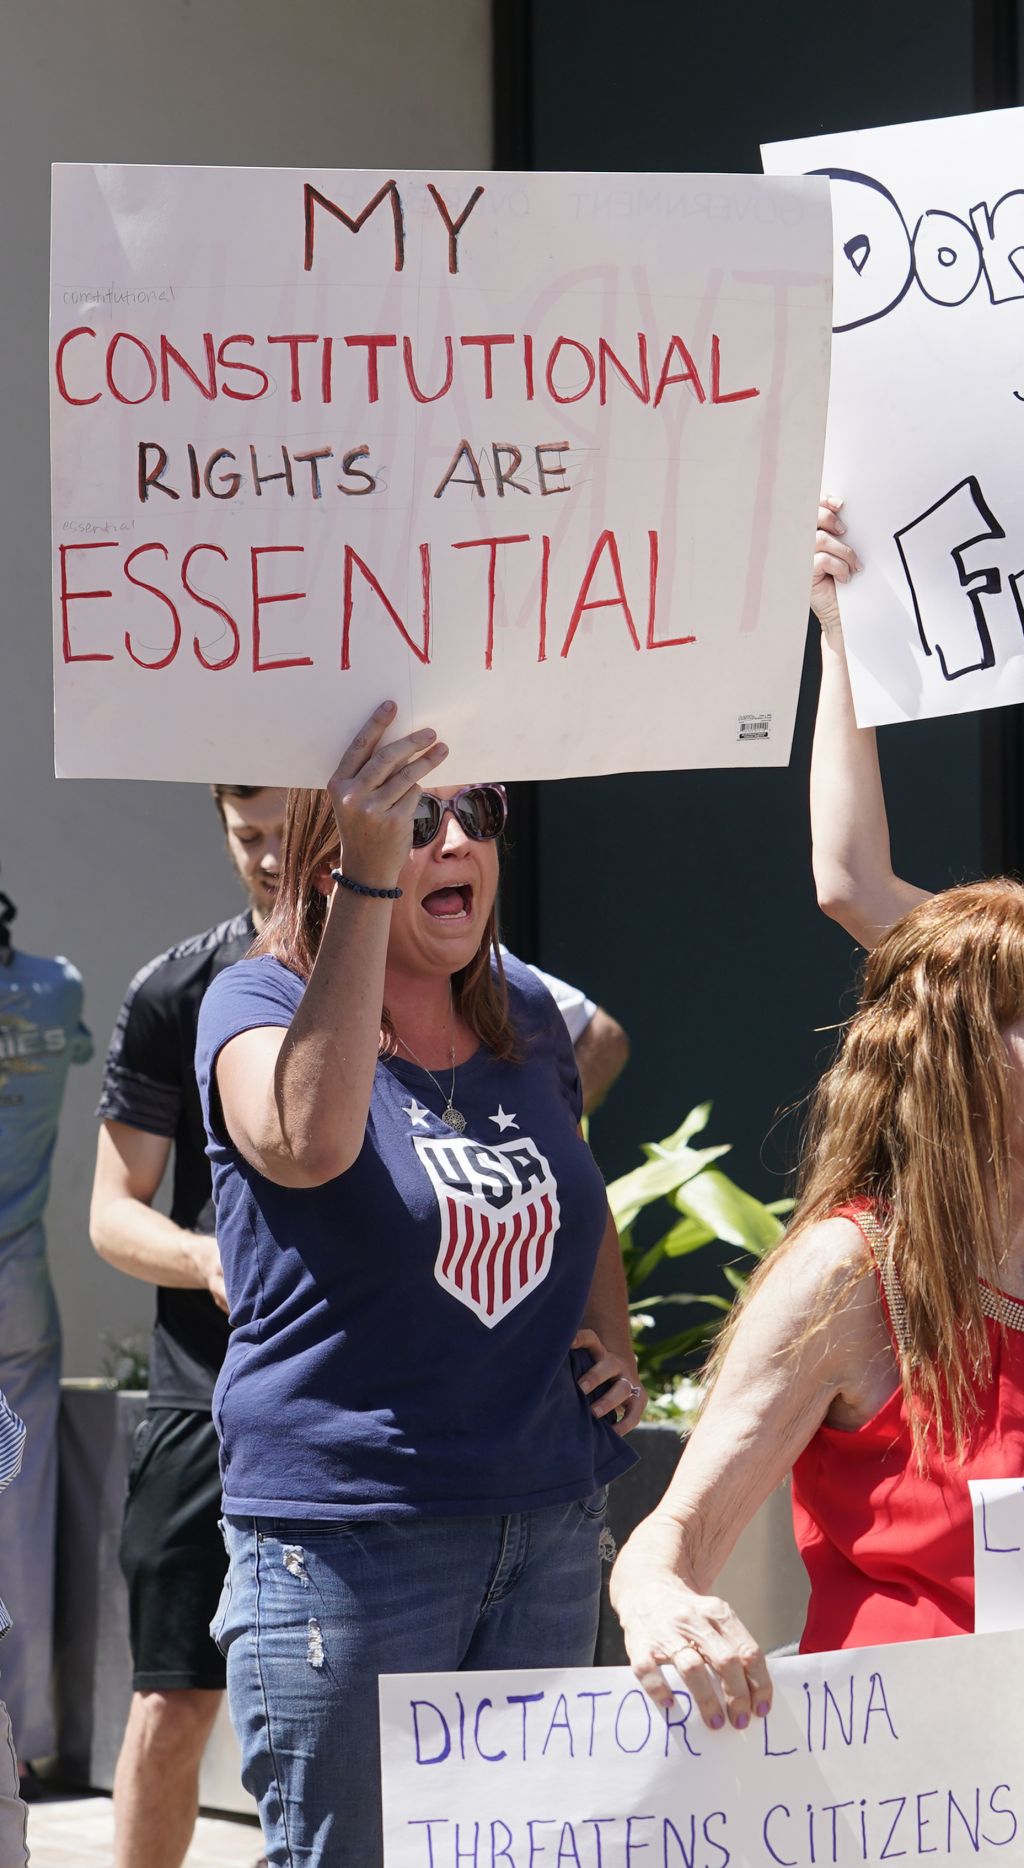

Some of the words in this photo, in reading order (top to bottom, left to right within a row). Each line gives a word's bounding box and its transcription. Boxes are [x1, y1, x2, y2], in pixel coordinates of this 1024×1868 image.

[303, 178, 486, 275] MY
[55, 327, 760, 407] CONSTITUTIONAL
[137, 441, 376, 503] RIGHTS
[434, 440, 571, 499] ARE
[58, 530, 697, 673] ESSENTIAL
[423, 1145, 546, 1210] USA
[410, 1689, 701, 1765] DICTATOR
